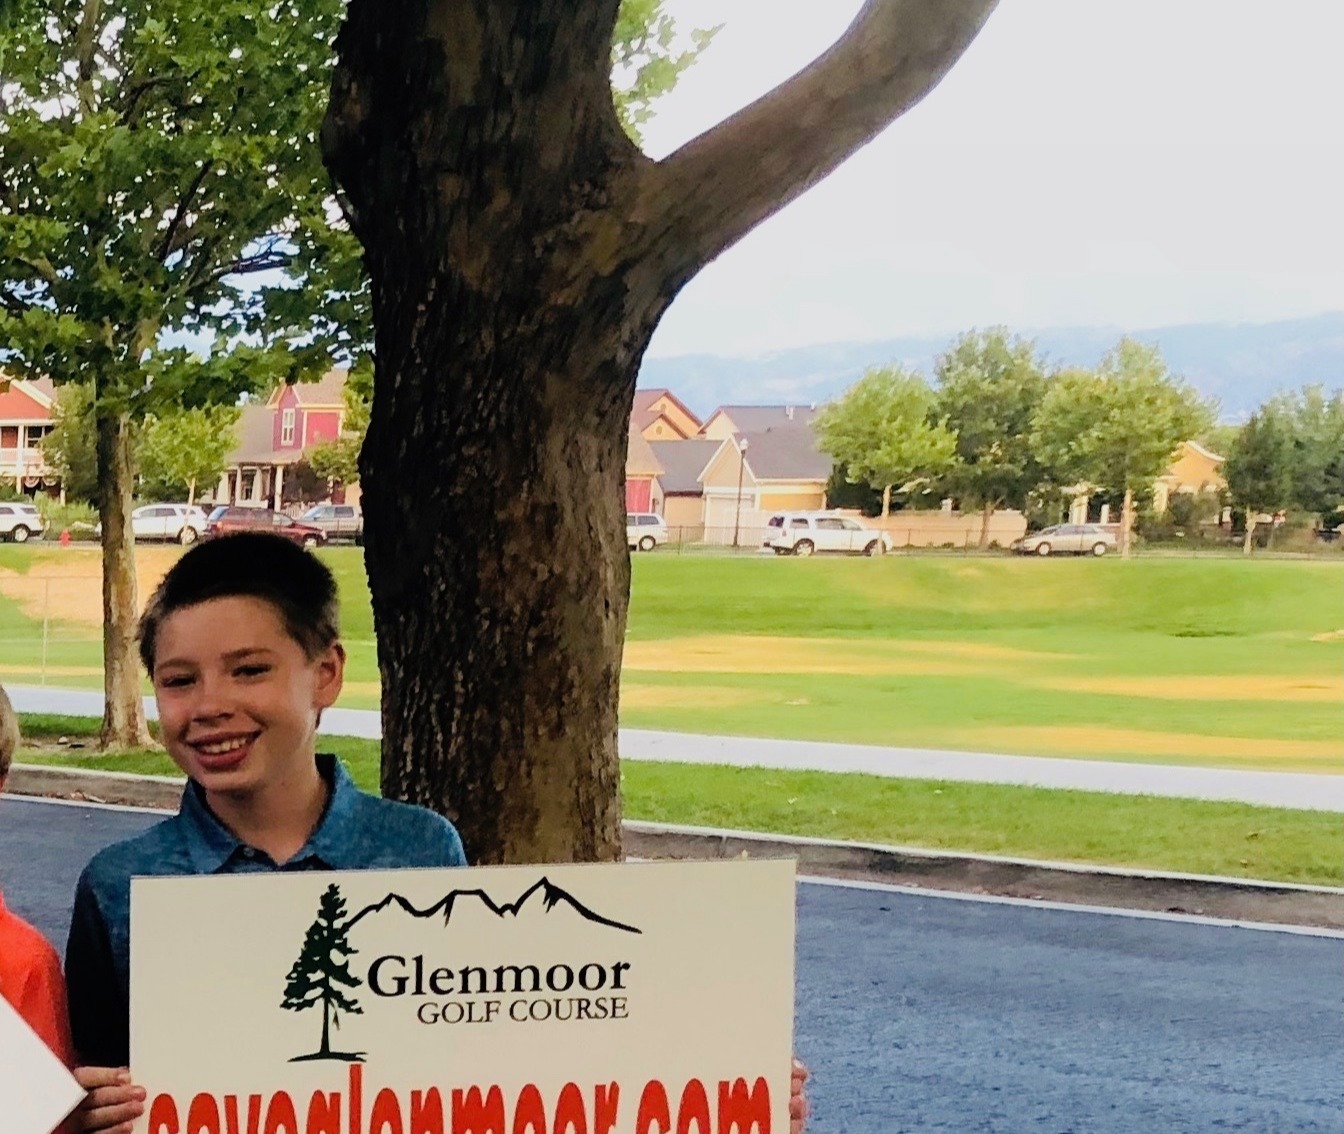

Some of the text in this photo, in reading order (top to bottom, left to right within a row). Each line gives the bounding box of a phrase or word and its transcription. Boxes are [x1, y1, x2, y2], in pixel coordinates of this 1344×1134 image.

[367, 954, 631, 999] Glenmoor
[417, 997, 630, 1024] GOLF COURSE
